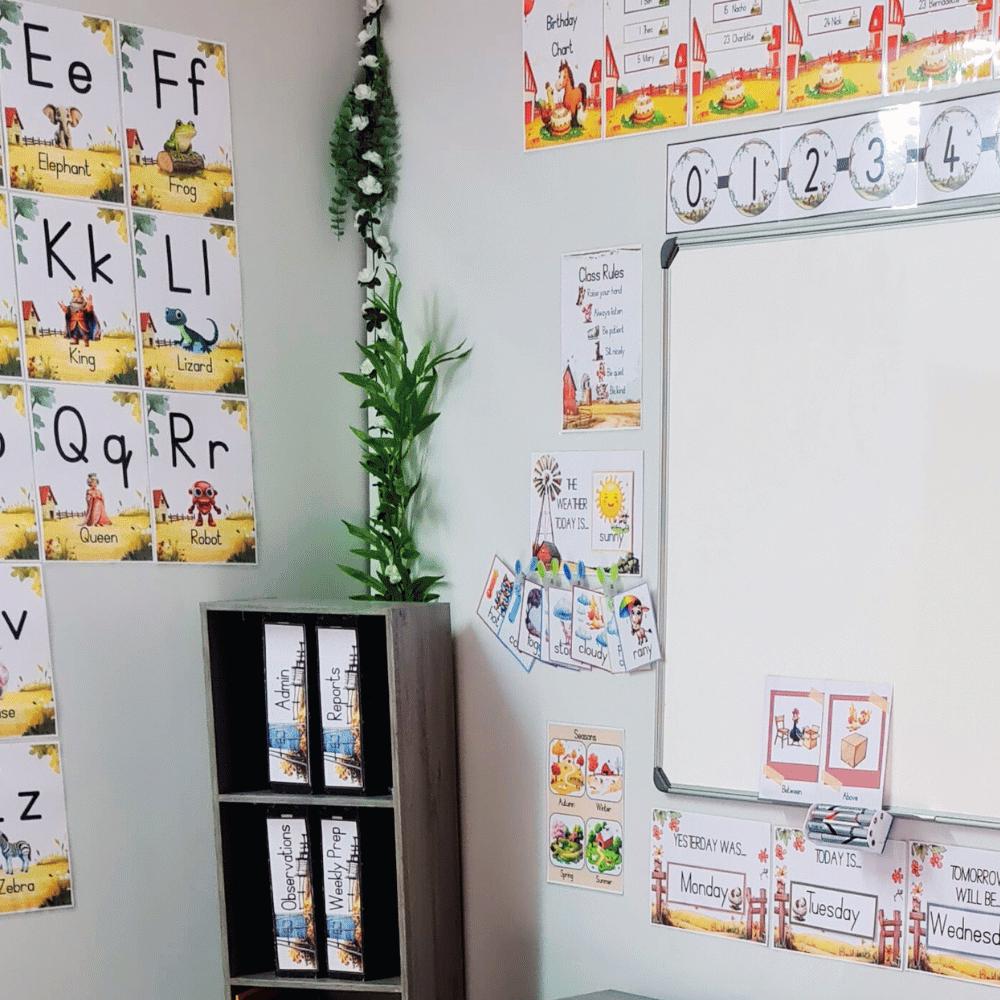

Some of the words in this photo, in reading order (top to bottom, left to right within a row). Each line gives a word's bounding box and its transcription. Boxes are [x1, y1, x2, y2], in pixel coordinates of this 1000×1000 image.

[546, 13, 577, 31] Birthday
[23, 22, 93, 94] Ee
[551, 41, 573, 57] Chart
[152, 49, 207, 116] Ff
[38, 151, 91, 179] Elephant
[686, 164, 702, 208] 0
[750, 156, 757, 201] 1
[804, 146, 819, 192] 2
[866, 136, 885, 184] 3
[942, 125, 960, 174] 4
[168, 176, 197, 203] Frog
[43, 218, 114, 285] Kk
[578, 266, 600, 283] Class
[602, 264, 625, 280] Rules
[69, 347, 97, 372] King
[176, 354, 213, 374] Lizard
[53, 405, 133, 489] Qq
[168, 411, 229, 469] Rr
[566, 478, 578, 490] THE
[556, 498, 588, 511] WEATHER
[555, 517, 576, 530] TODAY
[79, 526, 119, 545] Queen
[190, 528, 222, 546] Robot
[599, 532, 624, 548] sunny
[578, 640, 609, 667] cloudy
[632, 645, 653, 662] rainy
[274, 668, 290, 711] Admin
[326, 666, 342, 722] Reports
[573, 728, 597, 742] Seasons
[781, 783, 803, 796] Between
[842, 792, 859, 802] Above
[327, 826, 347, 860] Prep
[673, 832, 719, 851] YESTERDAY
[814, 848, 846, 866] TODAY
[280, 823, 297, 912] Observations
[0, 878, 35, 895] Zebra
[327, 859, 346, 911] Weekly
[680, 870, 730, 907] Monday
[955, 886, 984, 906] WILL
[806, 890, 861, 931] Tuesday
